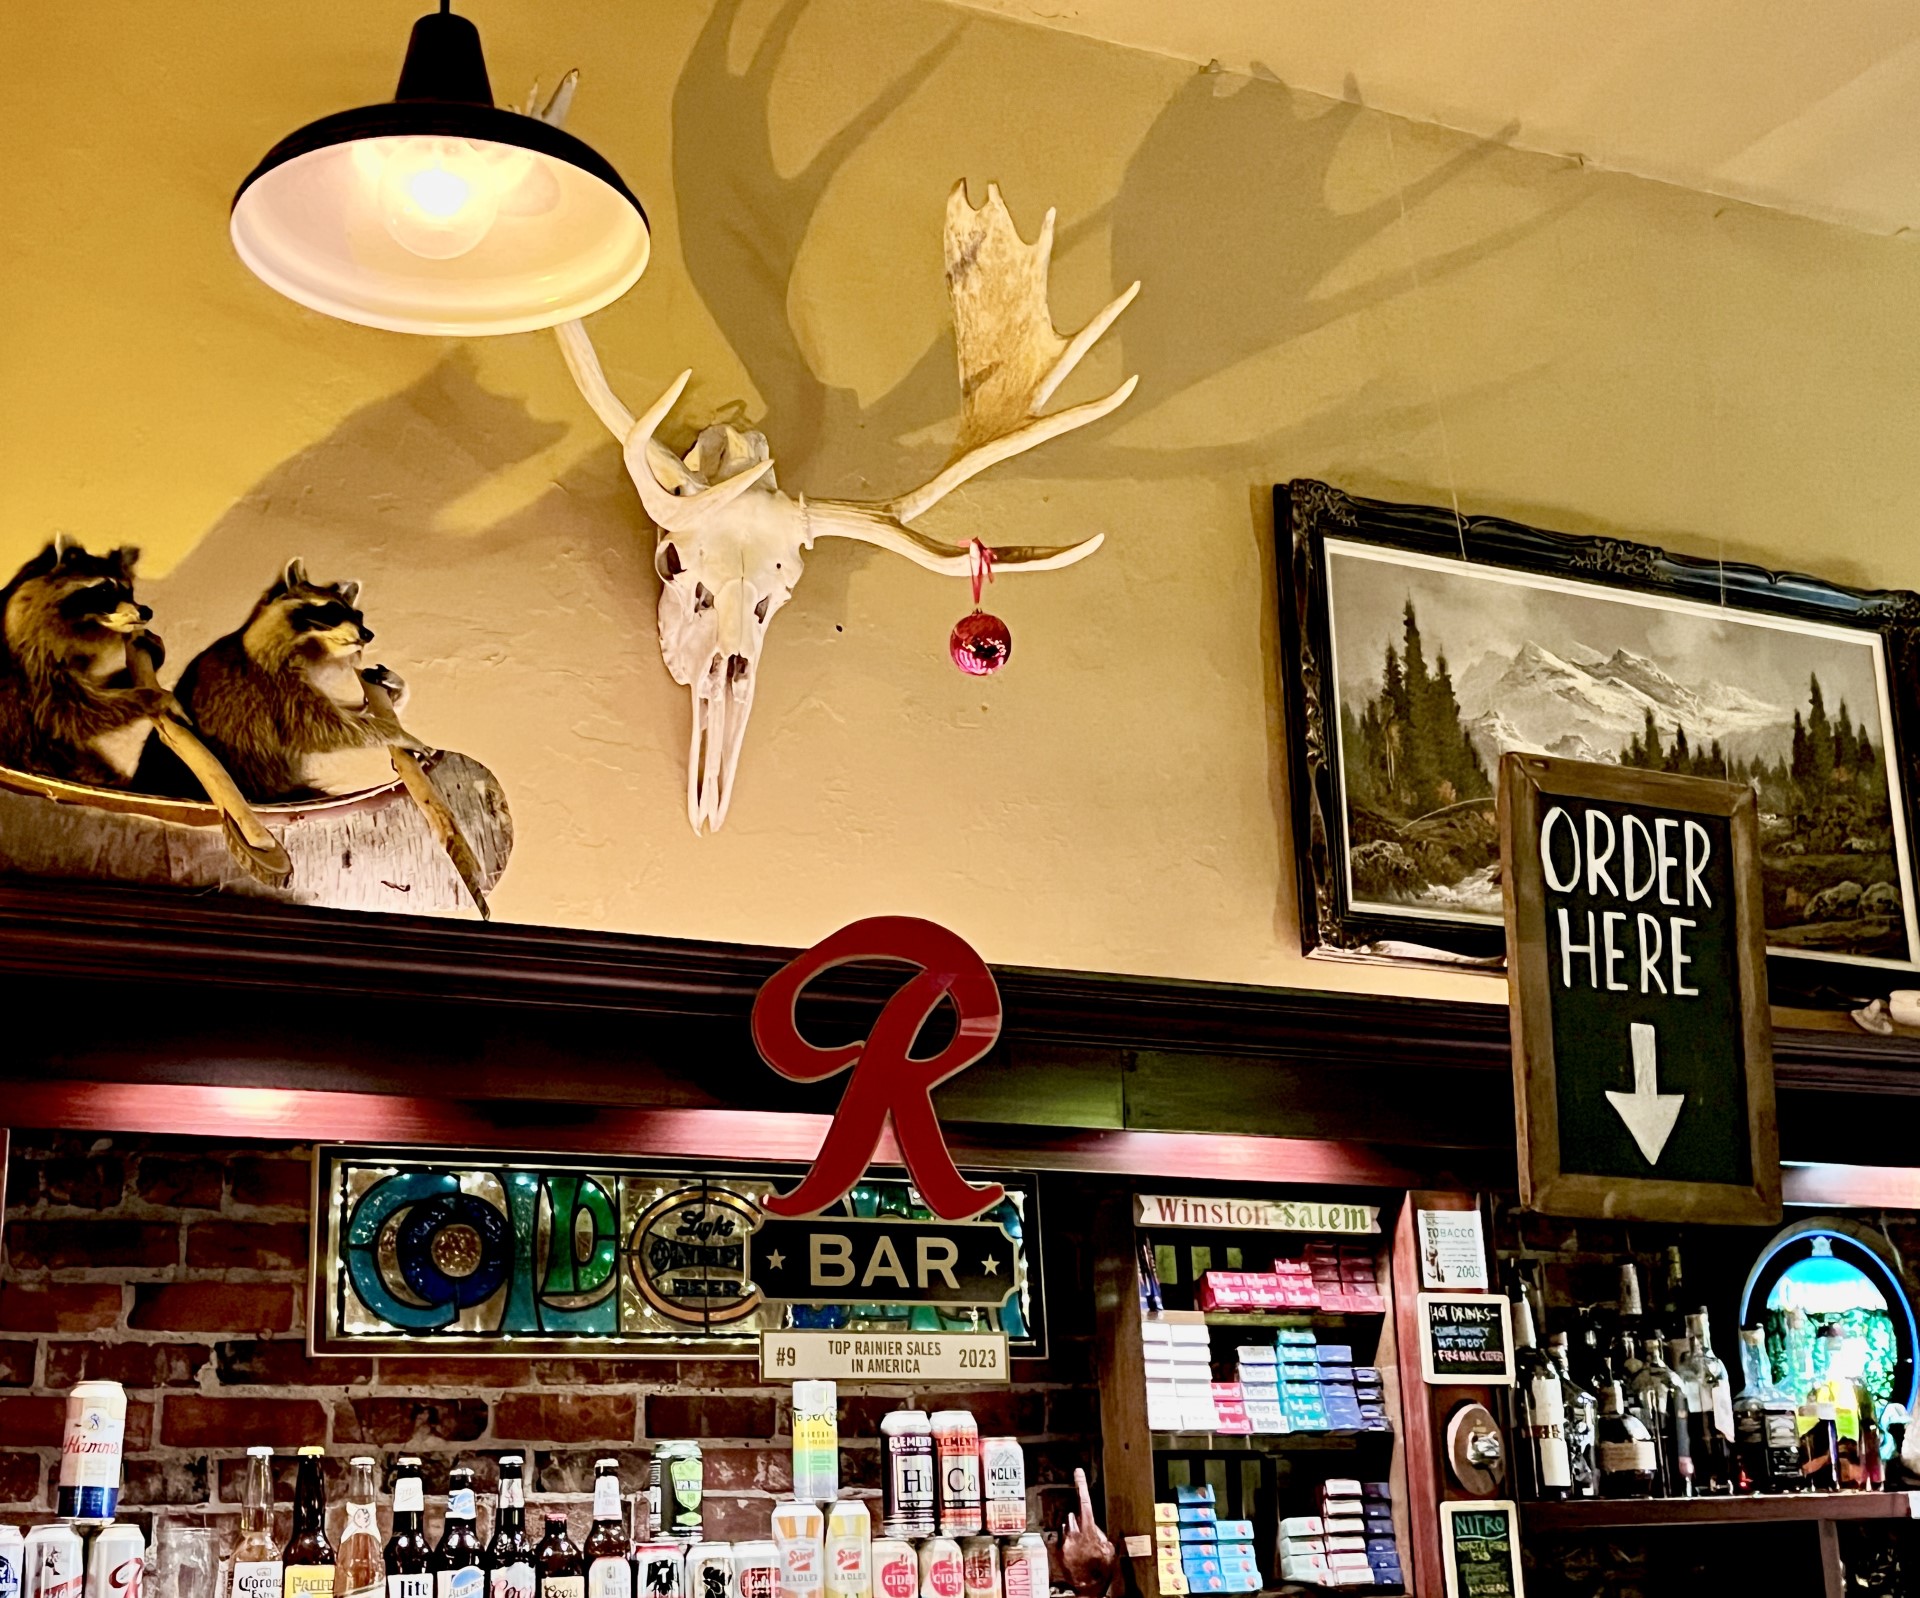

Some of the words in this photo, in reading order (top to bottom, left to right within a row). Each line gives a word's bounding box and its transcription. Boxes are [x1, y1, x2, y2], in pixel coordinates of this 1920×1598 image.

[1540, 805, 1712, 908] ORDER
[1556, 908, 1699, 996] HERE
[751, 915, 1005, 1218] R
[675, 1210, 736, 1241] Light
[1155, 1197, 1271, 1226] Winston
[1280, 1202, 1370, 1231] Salem
[1426, 1227, 1475, 1239] TOBACCO
[346, 1170, 618, 1334] COLD
[808, 1233, 961, 1290] BAR
[776, 1346, 796, 1367] #9
[828, 1340, 851, 1356] TOP
[854, 1341, 903, 1356] RAINIER
[906, 1341, 942, 1357] SALES
[958, 1348, 997, 1369] 2023
[851, 1358, 865, 1373] IN
[867, 1358, 921, 1374] AMERICA
[947, 1467, 977, 1493] Ca
[1455, 1514, 1506, 1536] NITRO
